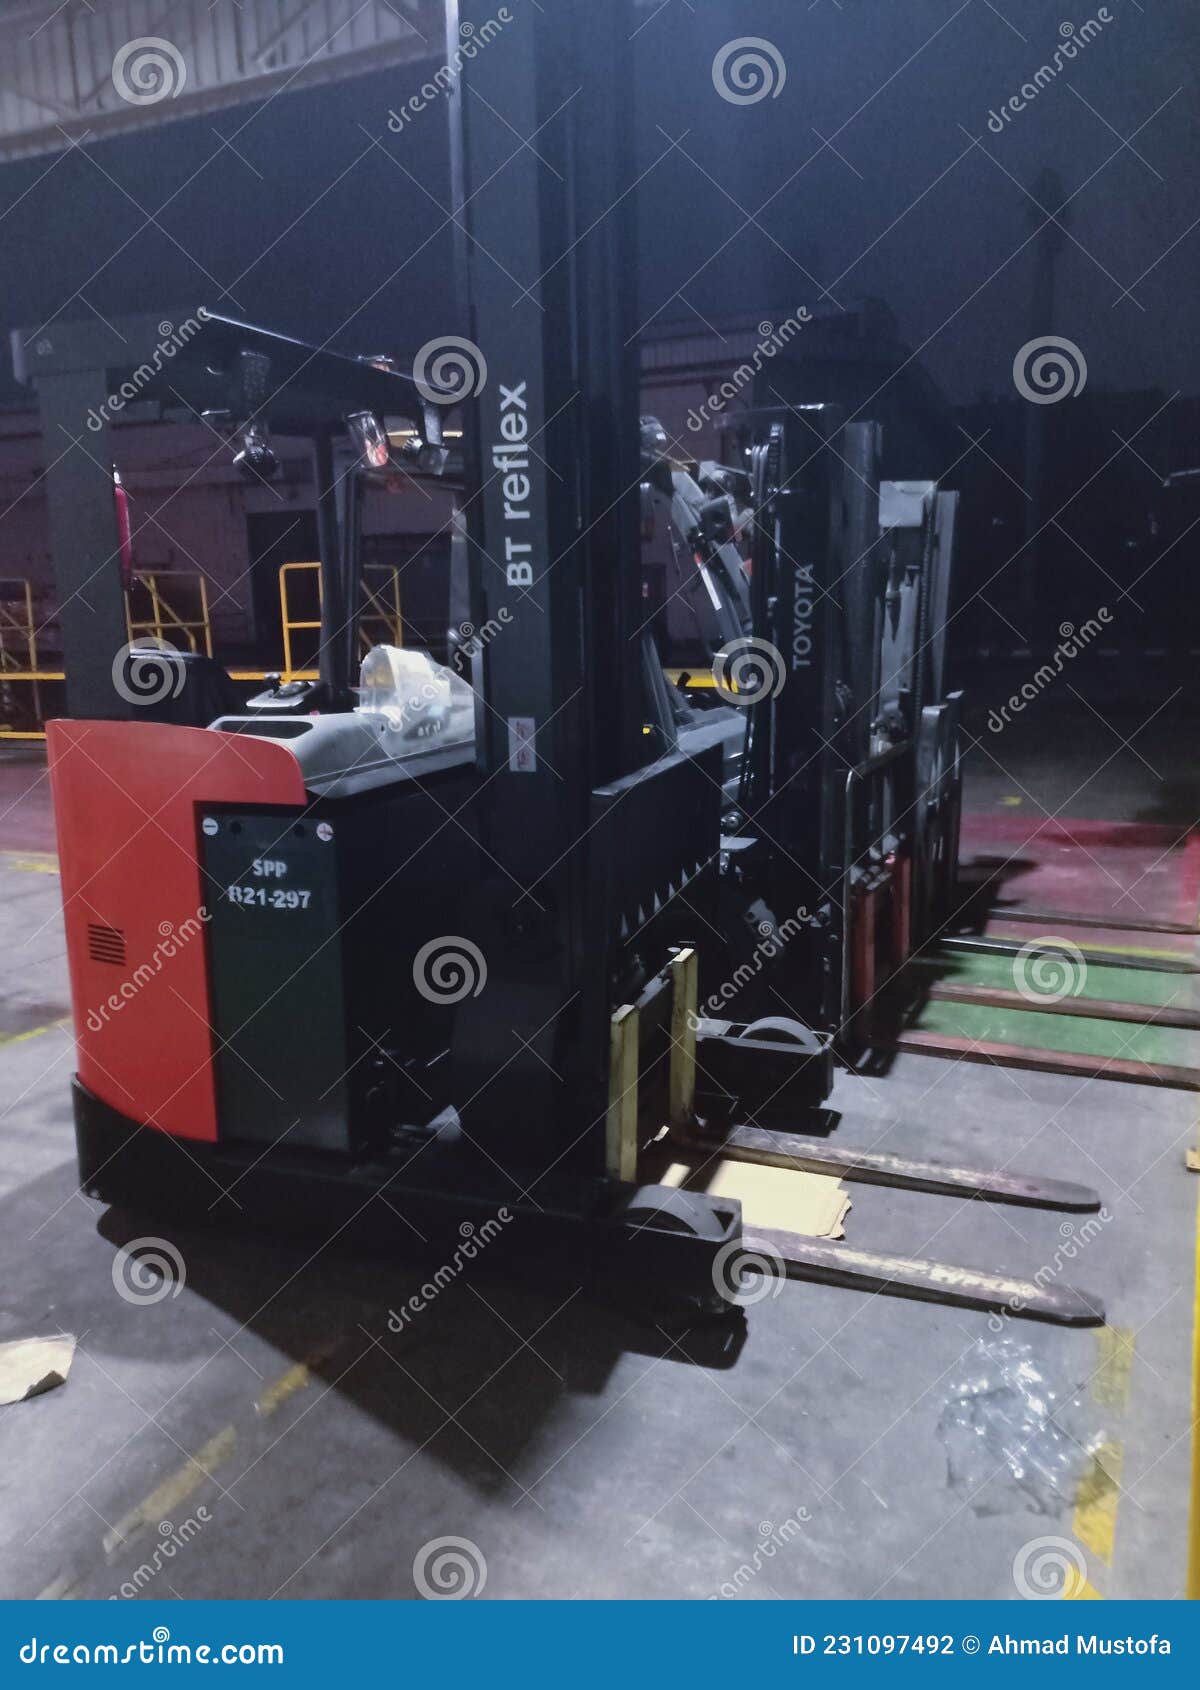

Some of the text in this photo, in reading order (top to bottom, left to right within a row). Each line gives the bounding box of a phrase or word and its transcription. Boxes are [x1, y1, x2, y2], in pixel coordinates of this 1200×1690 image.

[492, 381, 533, 587] BT reflex
[793, 564, 814, 671] TOYOTA
[252, 859, 287, 878] SPP
